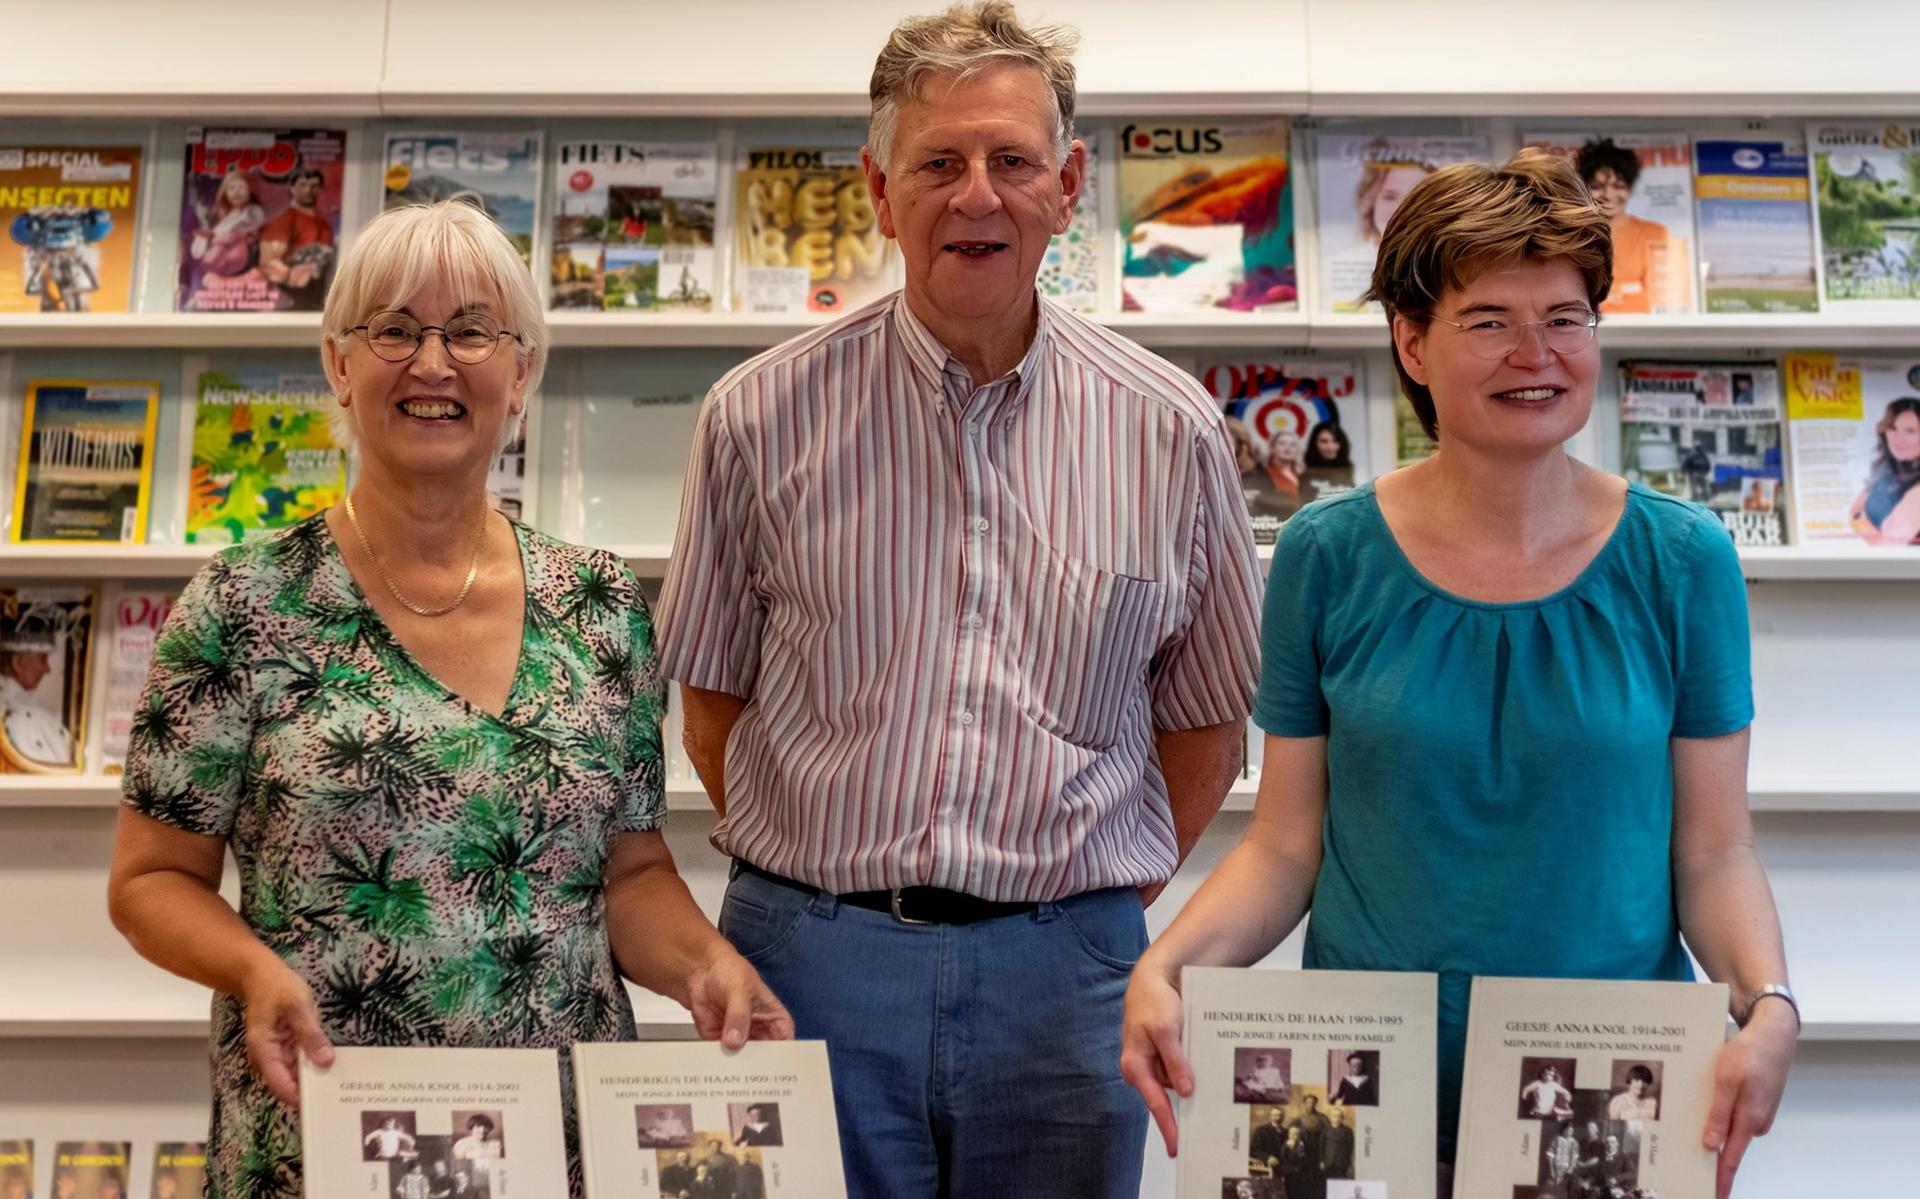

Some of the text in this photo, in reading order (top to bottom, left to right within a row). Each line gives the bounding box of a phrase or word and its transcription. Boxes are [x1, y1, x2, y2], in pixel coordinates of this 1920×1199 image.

[25, 151, 100, 168] SPECIAL
[561, 144, 645, 164] FIETS
[0, 186, 130, 209] NSECTEN
[38, 425, 137, 472] WILDERNIS
[1203, 1011, 1404, 1026] HENDERIKUS DE HAAN 1909-1995
[1217, 1030, 1396, 1043] MIJN JONGE JAREN EN MIJN FAMILIE
[1505, 1021, 1686, 1037] GEESJE ANNA KNOL 1914-2001
[1503, 1039, 1683, 1052] MIJN JONGE JAREN EN MIJN FAMILIE
[339, 1082, 520, 1092] GEESJE ANNA KNOL 1914-2001
[600, 1074, 798, 1085] HENDERIKUS DE HAAN 1909-1995
